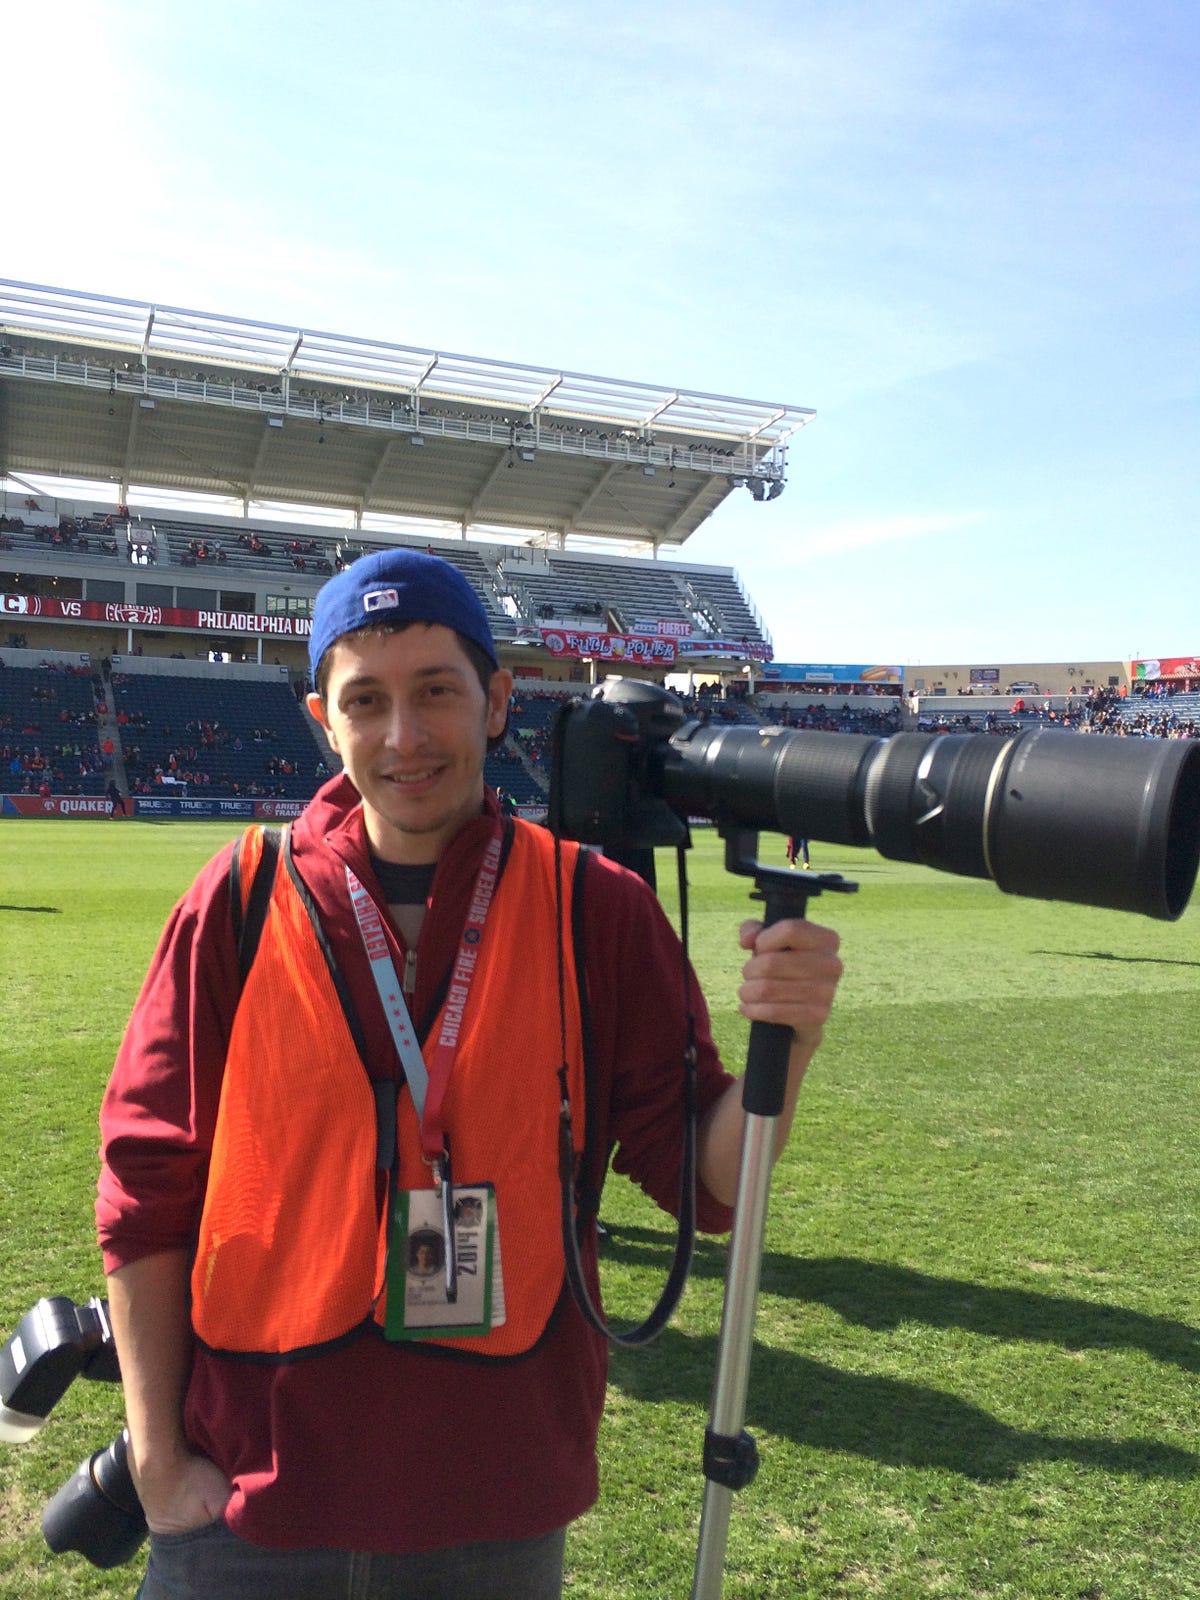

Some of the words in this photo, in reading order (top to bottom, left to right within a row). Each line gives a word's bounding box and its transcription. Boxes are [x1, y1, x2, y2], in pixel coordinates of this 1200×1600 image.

[60, 601, 81, 616] VS
[198, 611, 292, 634] PHILADELPHIA
[295, 619, 313, 635] UN
[658, 621, 692, 636] FUERTE
[569, 637, 610, 653] FULL
[60, 799, 114, 814] QUAKER
[275, 802, 300, 811] ARIES
[469, 871, 496, 925] SOCCER
[354, 894, 391, 962] CHICAGO
[439, 987, 470, 1048] CHICAGO
[455, 949, 478, 983] FIRE
